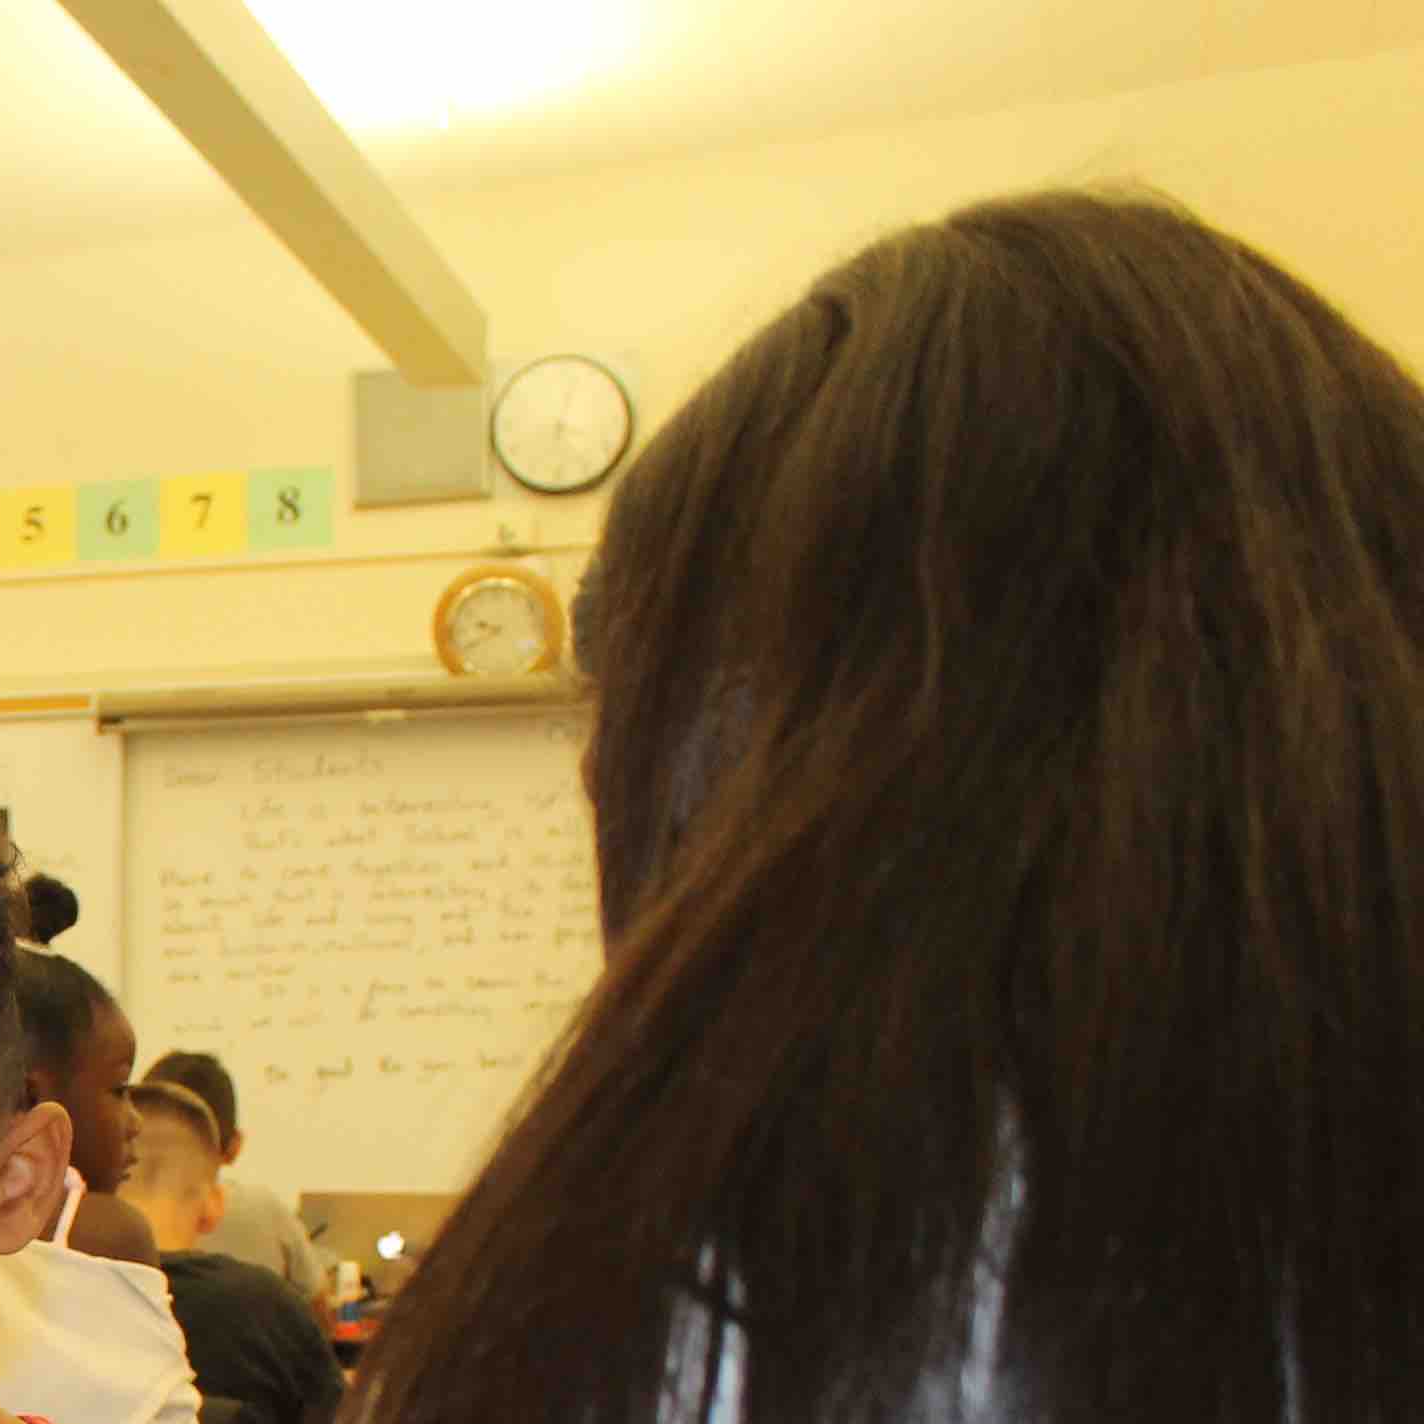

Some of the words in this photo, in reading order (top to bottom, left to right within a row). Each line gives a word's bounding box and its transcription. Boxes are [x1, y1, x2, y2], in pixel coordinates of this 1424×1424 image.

[19, 504, 47, 544] 5
[104, 498, 129, 537] 6
[189, 491, 213, 529] 7
[275, 485, 302, 526] 8
